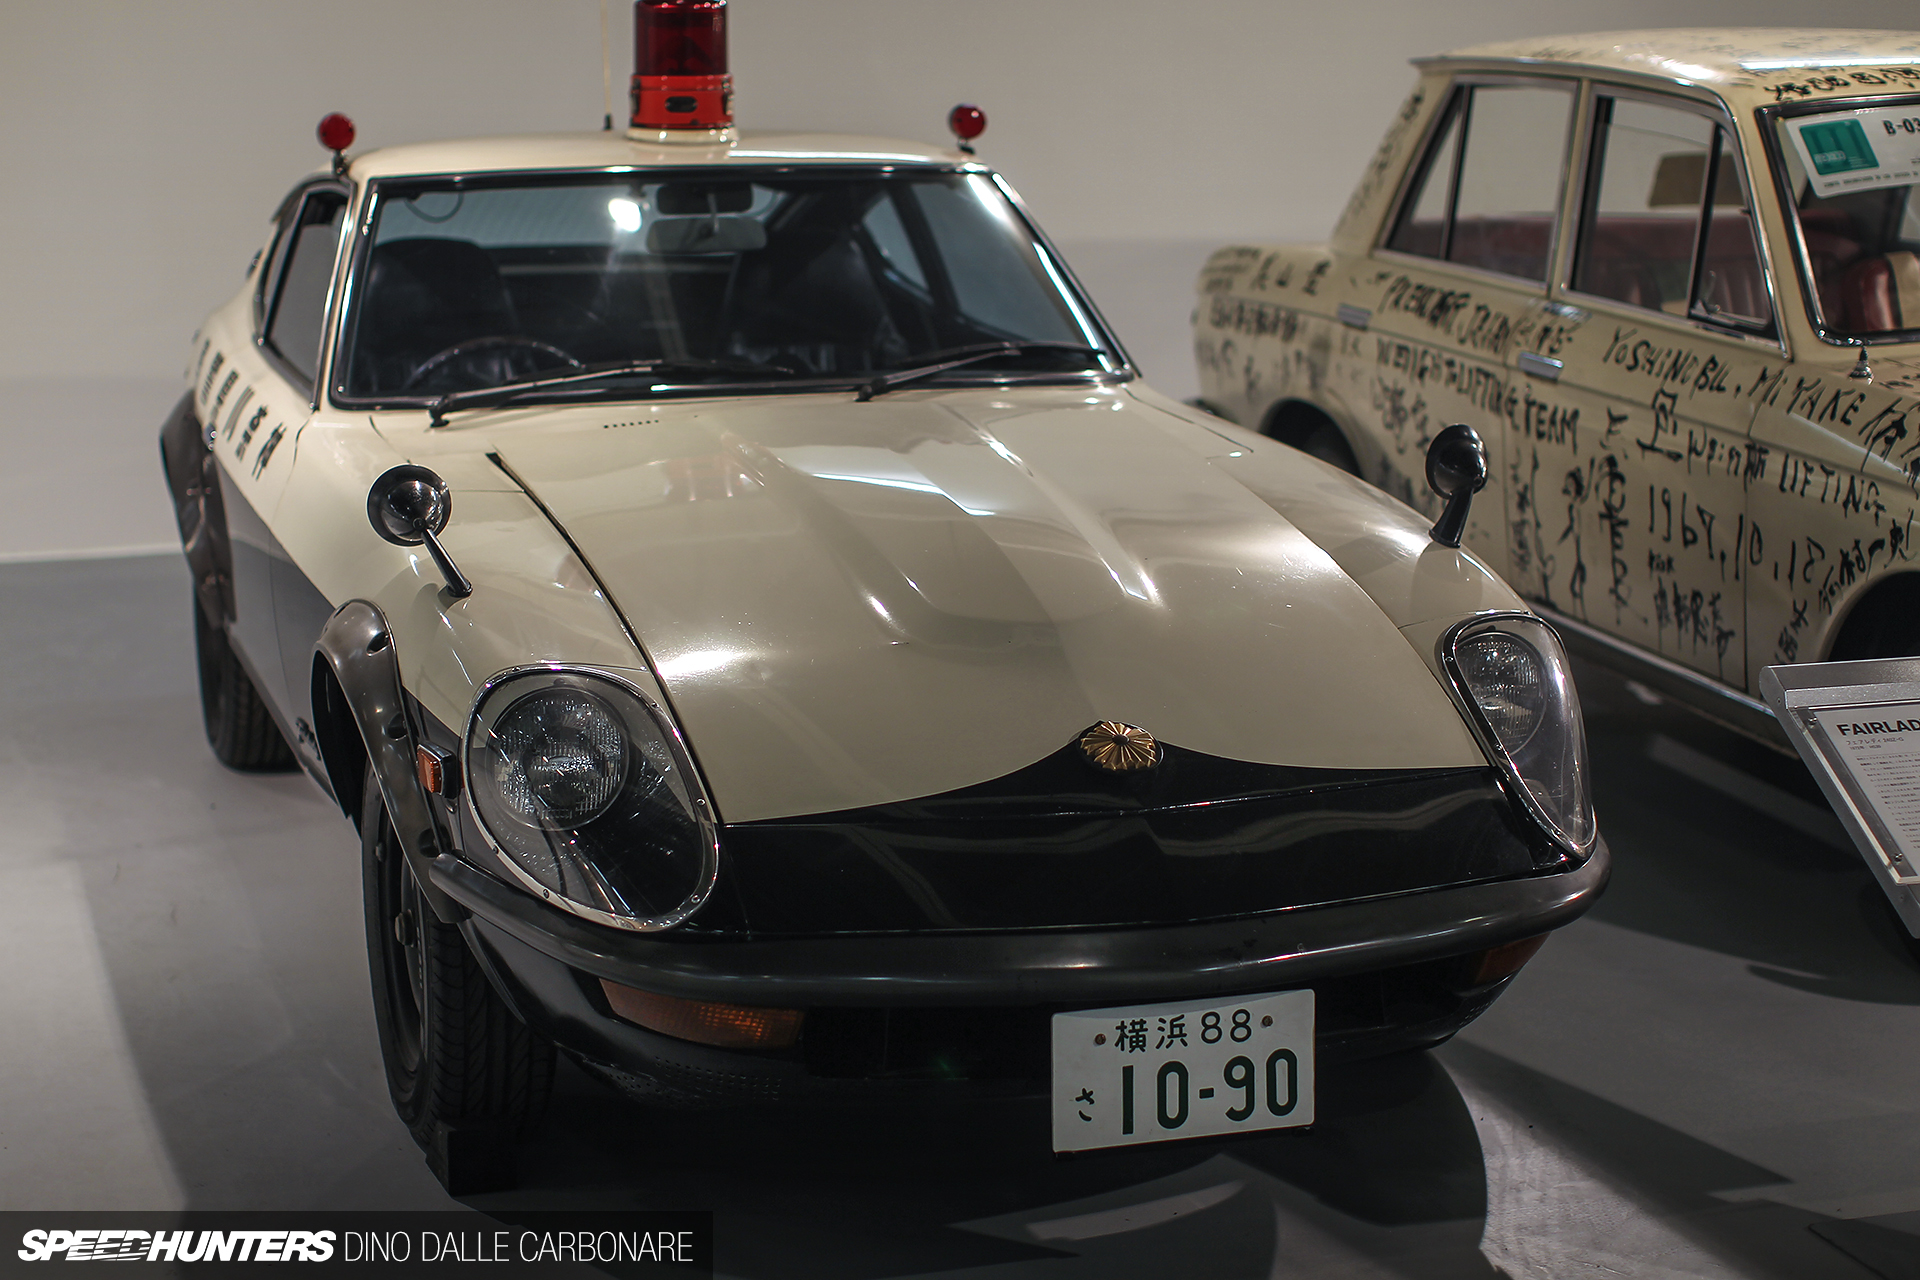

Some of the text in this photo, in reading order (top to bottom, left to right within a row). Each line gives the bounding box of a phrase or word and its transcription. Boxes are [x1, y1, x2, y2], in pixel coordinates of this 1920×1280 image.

[1836, 719, 1920, 736] FAIRLAD
[1114, 1008, 1252, 1053] 横浜 88
[1075, 1048, 1298, 1135] さ 10-90
